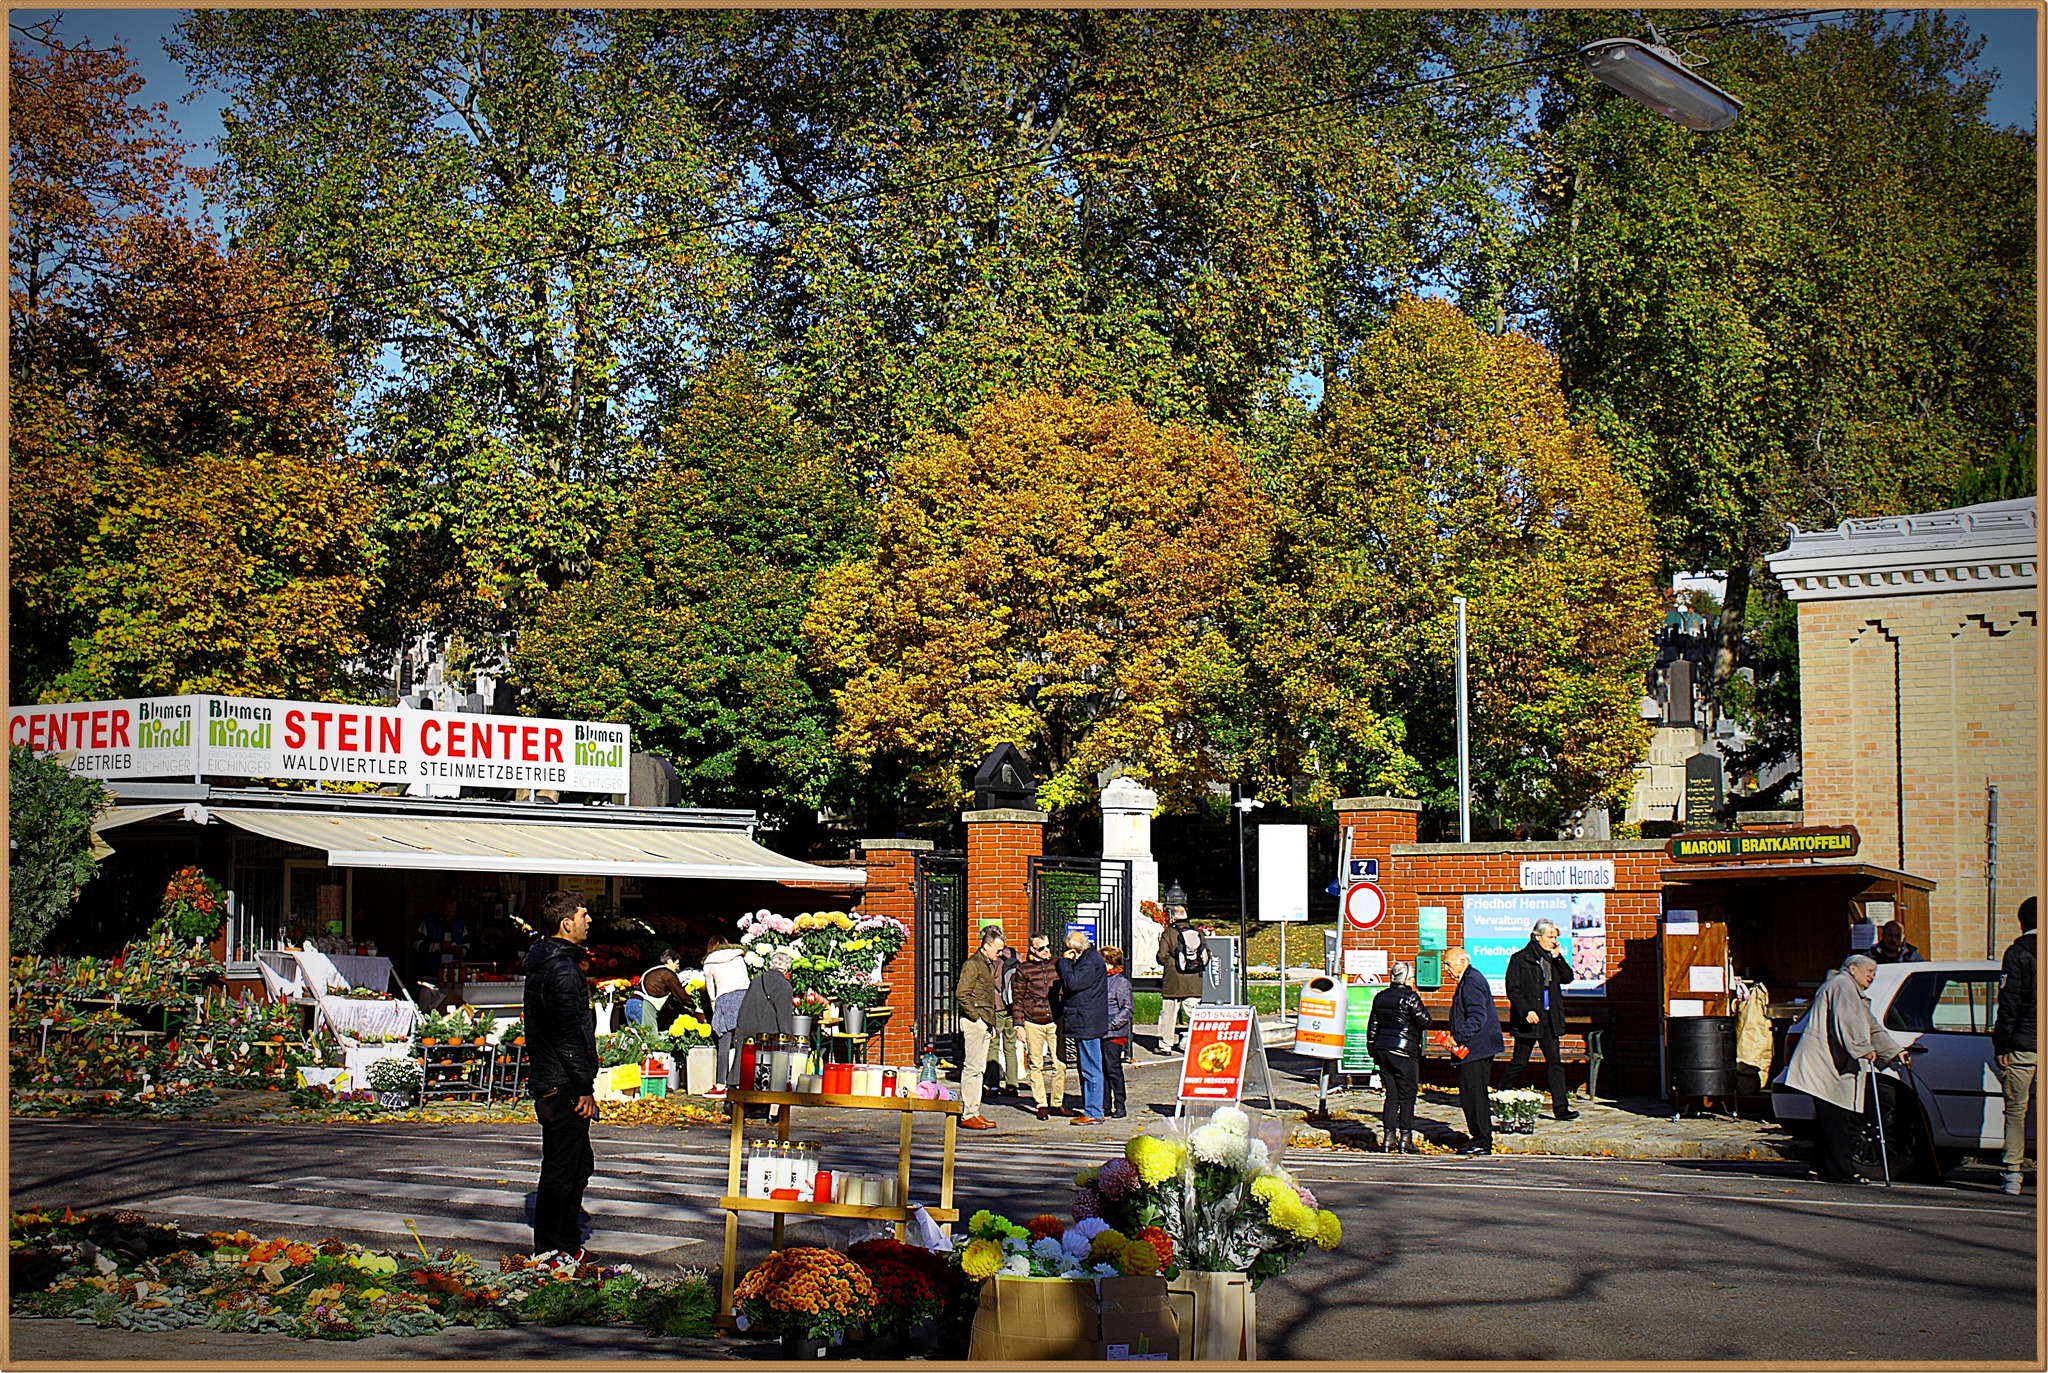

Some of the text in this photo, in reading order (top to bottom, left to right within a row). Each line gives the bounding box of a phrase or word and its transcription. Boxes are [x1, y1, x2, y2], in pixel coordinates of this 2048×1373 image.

[140, 702, 191, 720] Blumen
[210, 699, 272, 721] Blumen
[284, 709, 564, 763] STEIN CENTER
[575, 725, 623, 743] Blumen
[137, 758, 191, 774] EICHINGER
[208, 759, 272, 774] EICHINGER
[283, 754, 566, 782] WALDVIERTLER STEINMETZBETRIEB
[574, 776, 623, 790] EICHINGER
[1681, 834, 1851, 855] MARONI BRATKARTOFFELN
[1358, 861, 1368, 875] 7
[1524, 865, 1610, 886] Friedhof Hernals
[1466, 897, 1567, 910] Friedhof Hernals
[1473, 915, 1531, 927] Verwaltung
[1217, 1031, 1246, 1040] ESSEN
